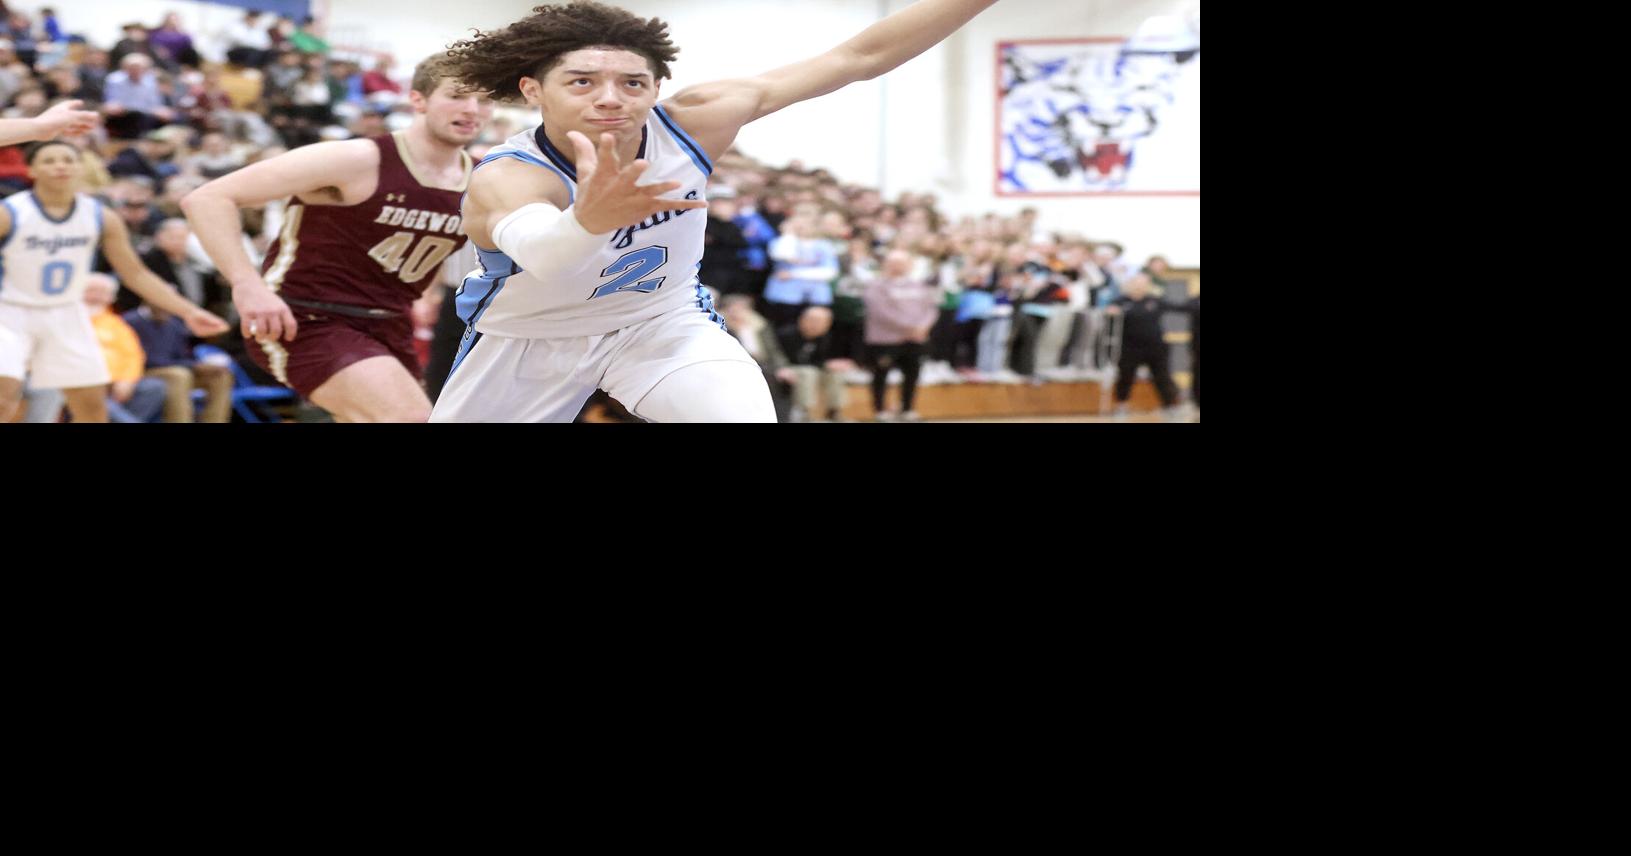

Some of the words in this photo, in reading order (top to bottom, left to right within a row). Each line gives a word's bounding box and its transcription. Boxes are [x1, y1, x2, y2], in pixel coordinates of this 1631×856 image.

[41, 261, 74, 296] 0
[367, 231, 457, 284] 40
[586, 245, 668, 301] 2
